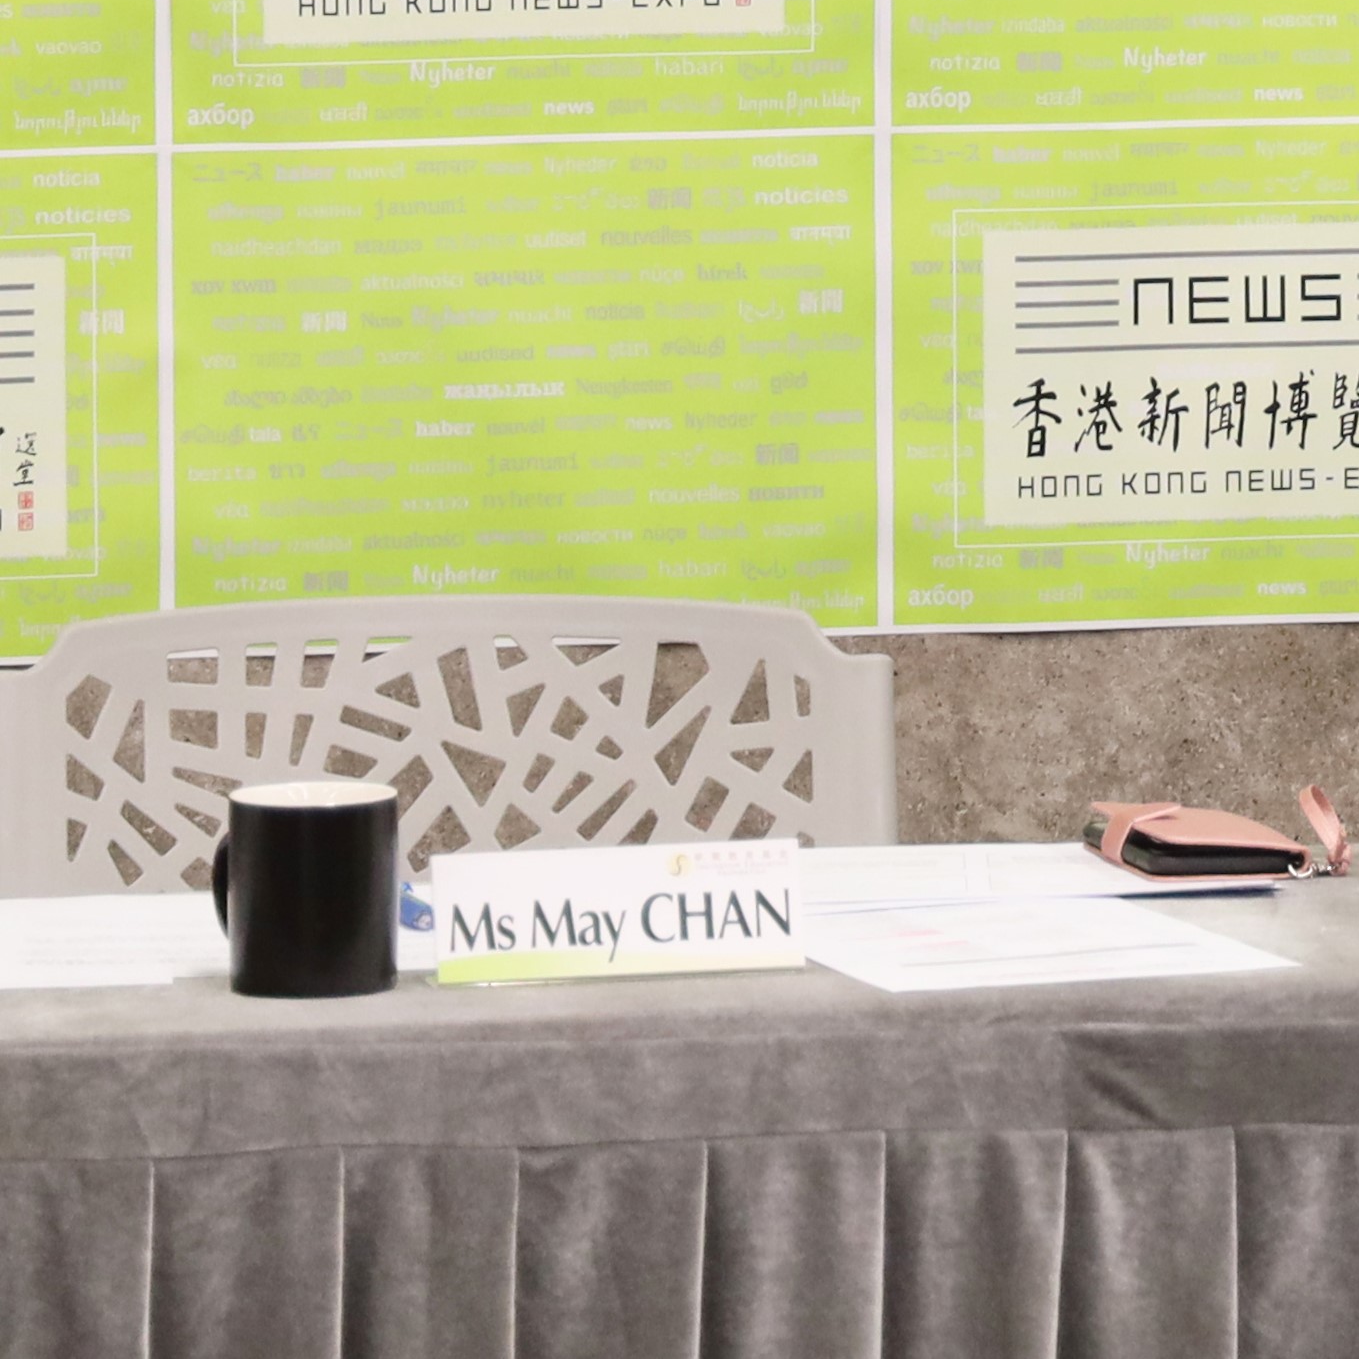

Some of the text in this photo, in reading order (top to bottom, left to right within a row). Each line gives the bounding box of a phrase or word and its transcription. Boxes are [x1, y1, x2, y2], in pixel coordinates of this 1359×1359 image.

[1123, 46, 1208, 74] Nyheter
[409, 61, 496, 85] Nyheter
[1254, 88, 1304, 101] news
[543, 101, 595, 115] news
[1018, 474, 1102, 498] HONG
[1122, 471, 1207, 495] KONG
[450, 889, 791, 963] Ms May CHAN
